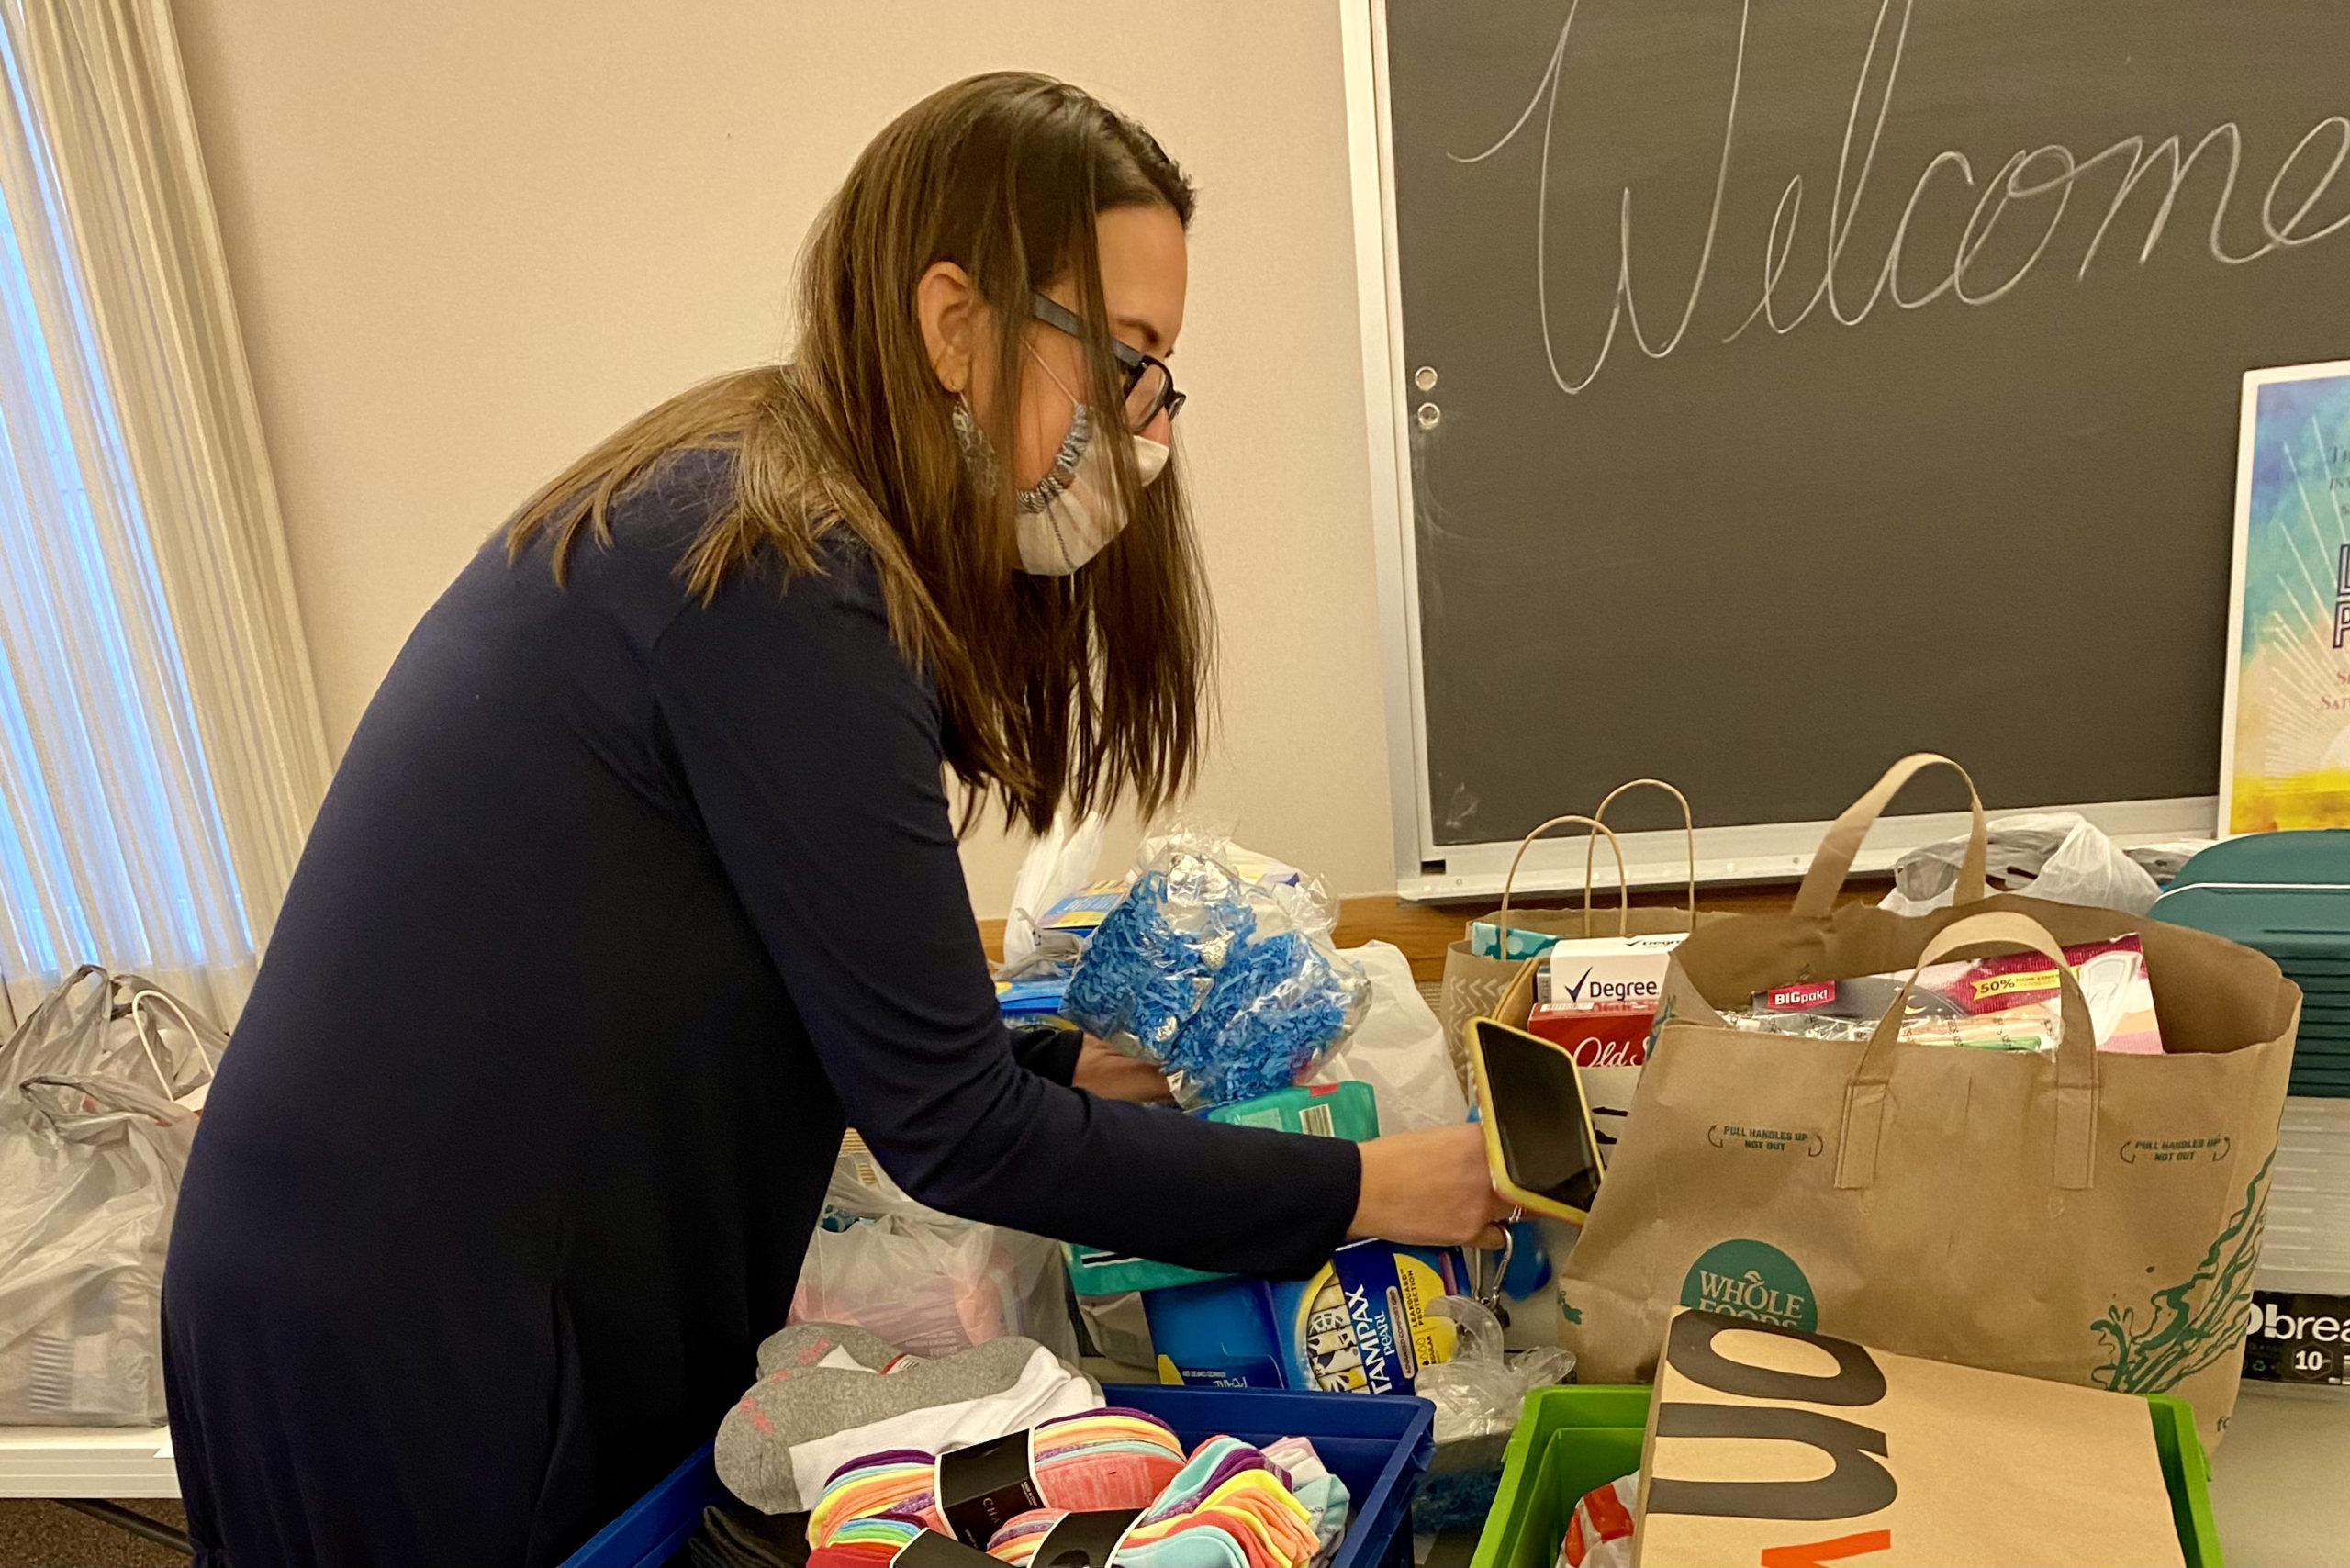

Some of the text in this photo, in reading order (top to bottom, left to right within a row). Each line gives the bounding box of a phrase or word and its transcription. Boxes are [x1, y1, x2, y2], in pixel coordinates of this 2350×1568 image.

[1447, 0, 2350, 394] Welcome
[1590, 980, 1658, 1002] Degree
[1980, 979, 2015, 993] 50%
[1573, 1036, 1630, 1067] Old
[1723, 1126, 1808, 1142] PULL HANDLES UP
[1744, 1139, 1786, 1151] NOT OUT
[2154, 1151, 2196, 1162] NOT OUT
[1407, 1270, 1424, 1327] PROTECTION
[1699, 1270, 1804, 1319] WHOLE
[1345, 1284, 1393, 1394] TAMPAX
